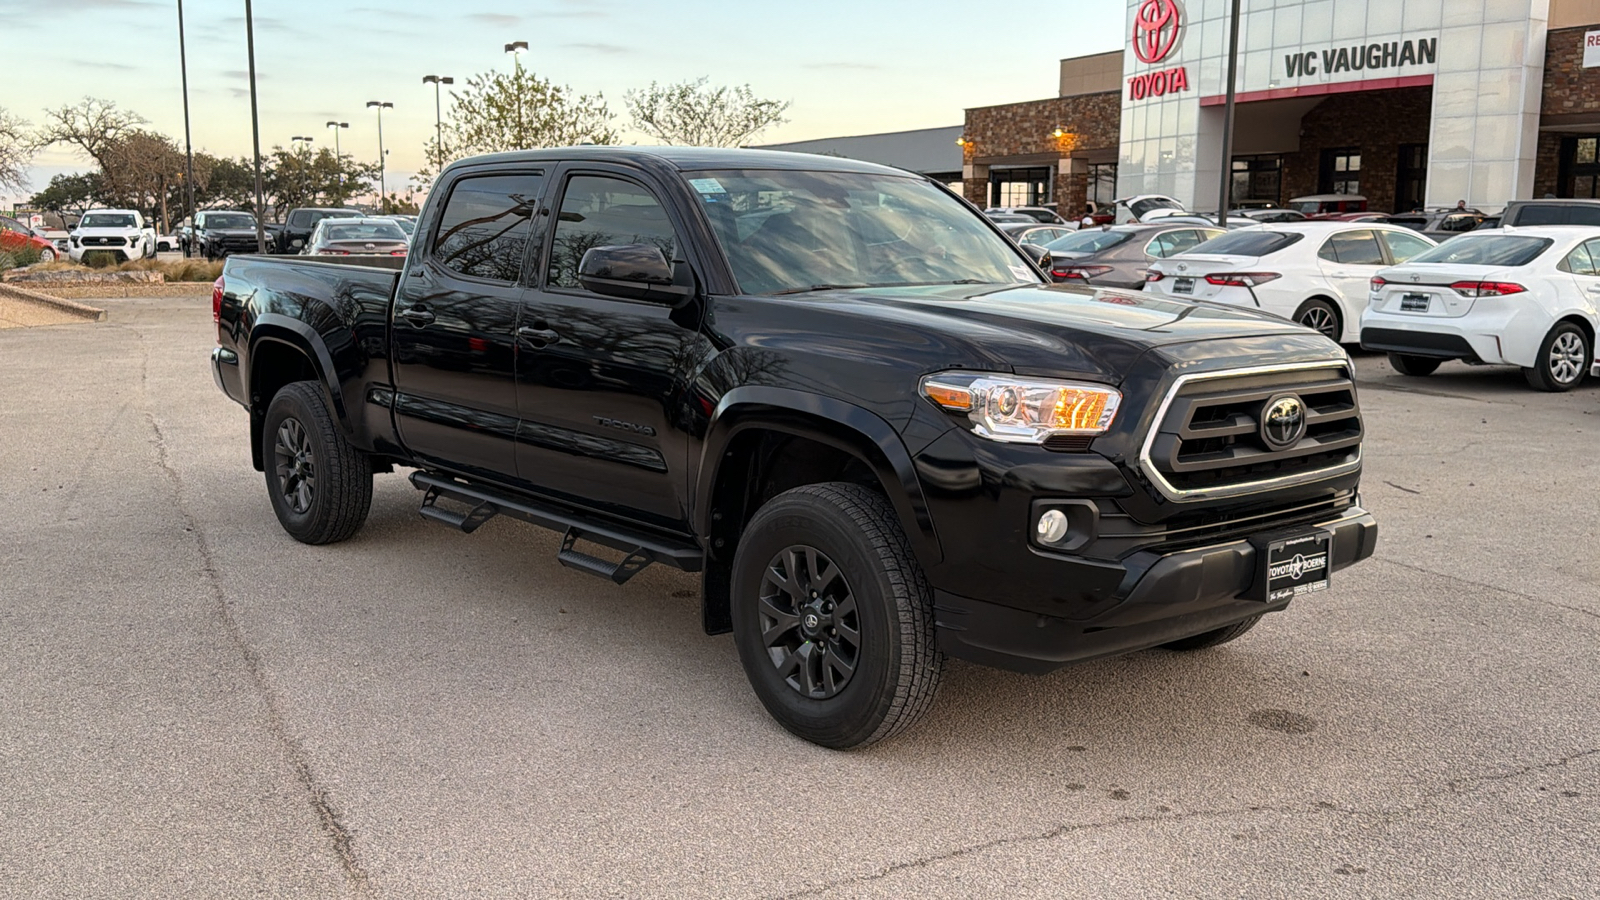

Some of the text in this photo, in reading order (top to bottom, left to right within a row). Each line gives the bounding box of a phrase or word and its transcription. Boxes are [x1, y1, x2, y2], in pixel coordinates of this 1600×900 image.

[1285, 38, 1437, 78] VIC VAUGHAN
[1127, 66, 1189, 101] TOYOTA
[1269, 556, 1326, 577] TOYOTA BOERNE
